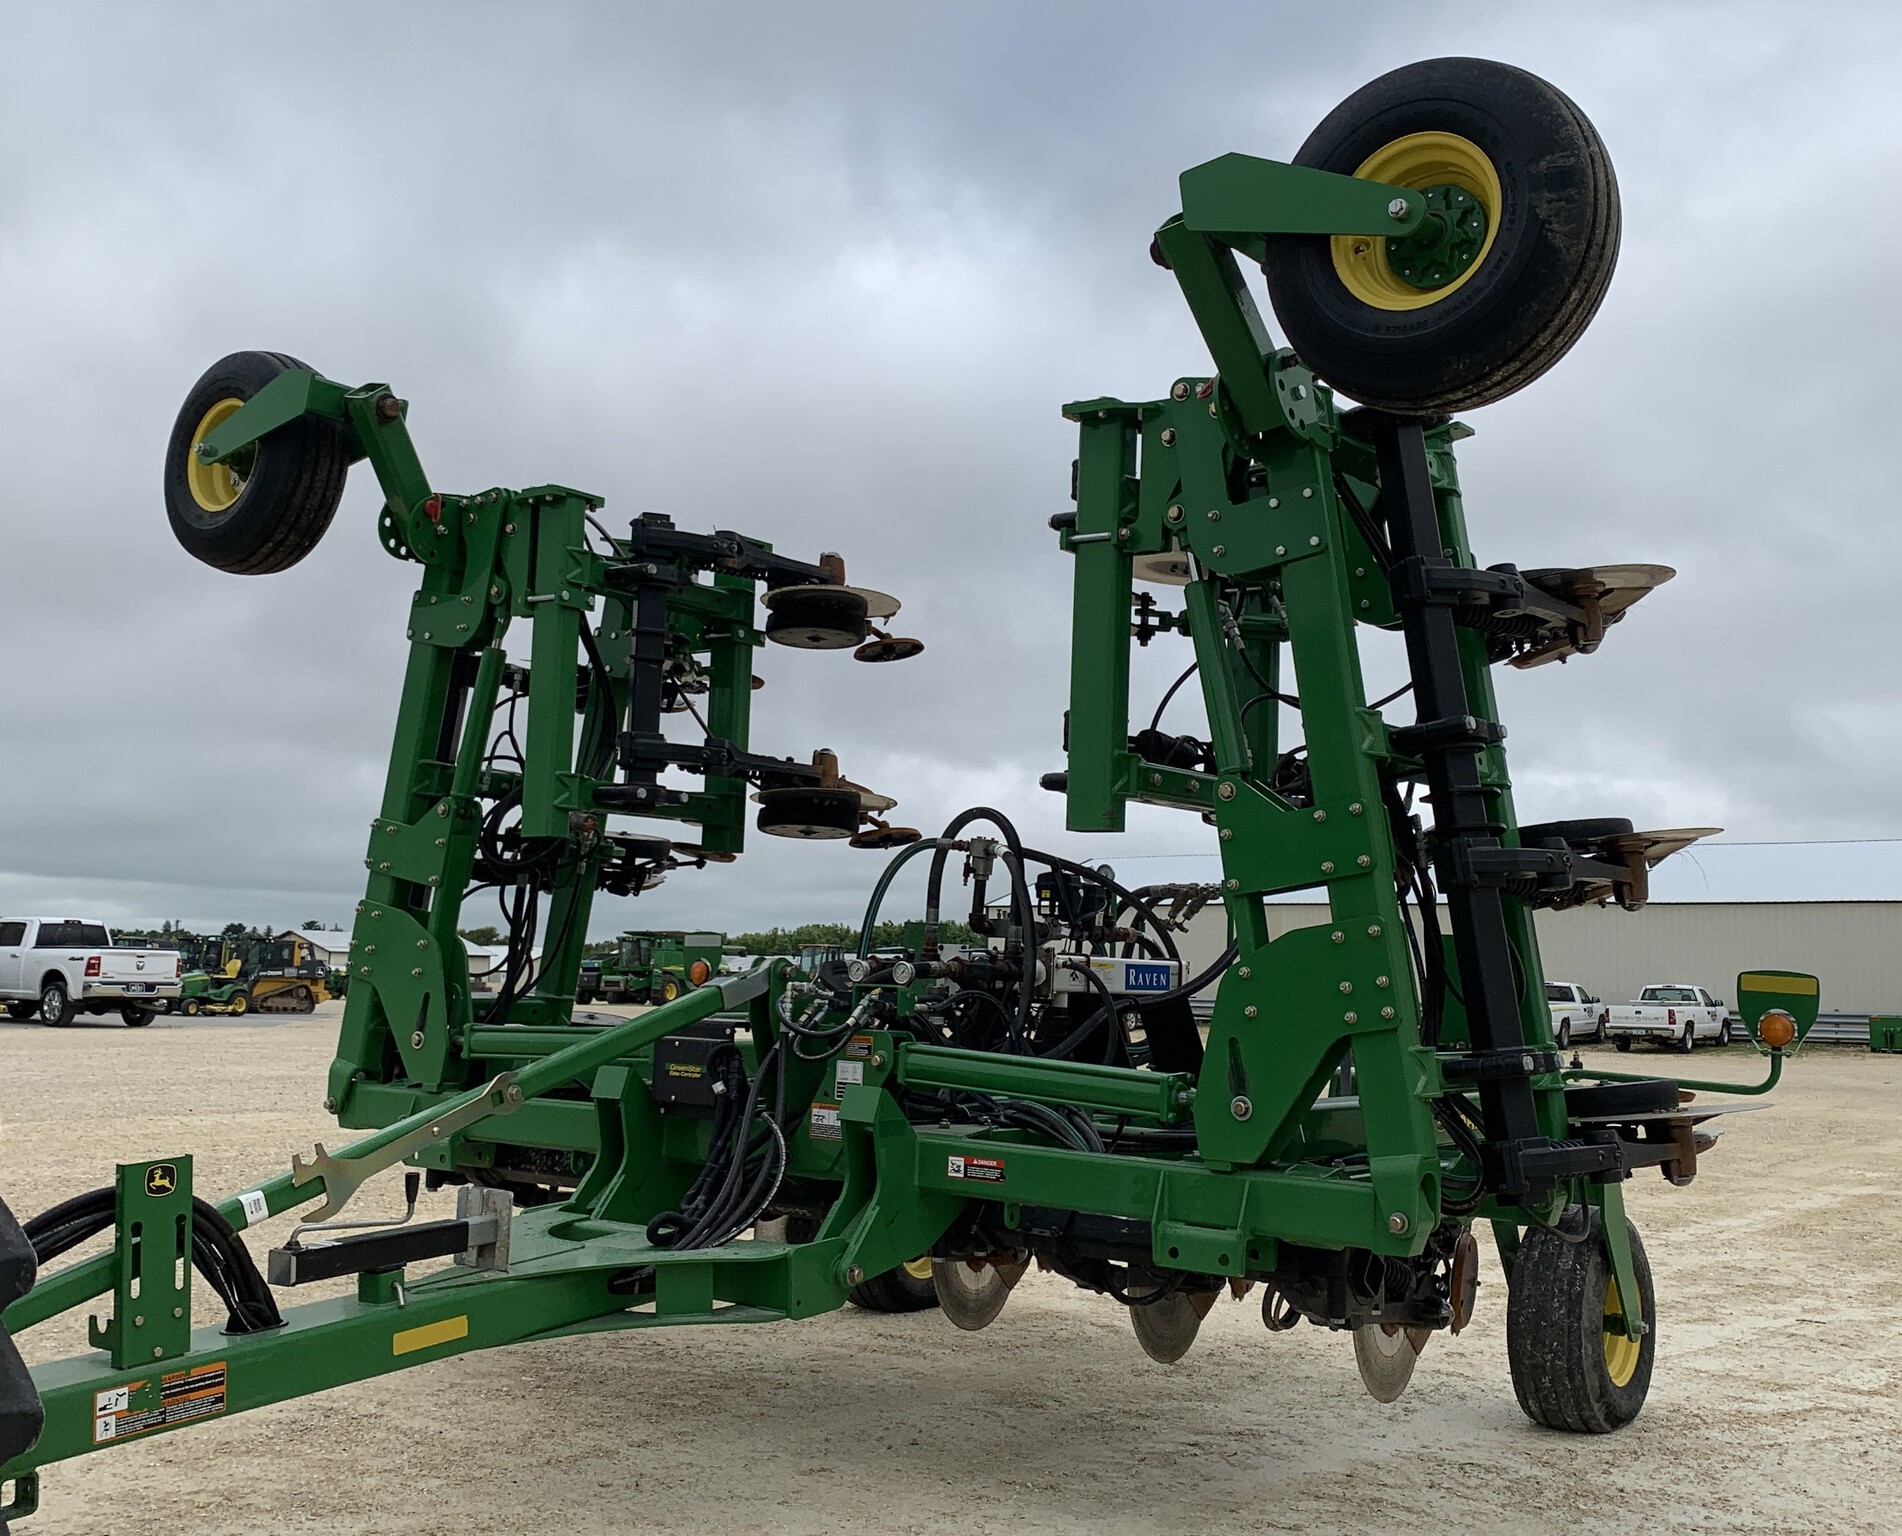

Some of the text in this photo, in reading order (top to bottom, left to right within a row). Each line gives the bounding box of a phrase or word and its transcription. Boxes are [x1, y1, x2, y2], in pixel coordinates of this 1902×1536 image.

[1129, 968, 1167, 986] RAVEN
[670, 1063, 702, 1072] GreenStar
[977, 1159, 998, 1167] DANGER
